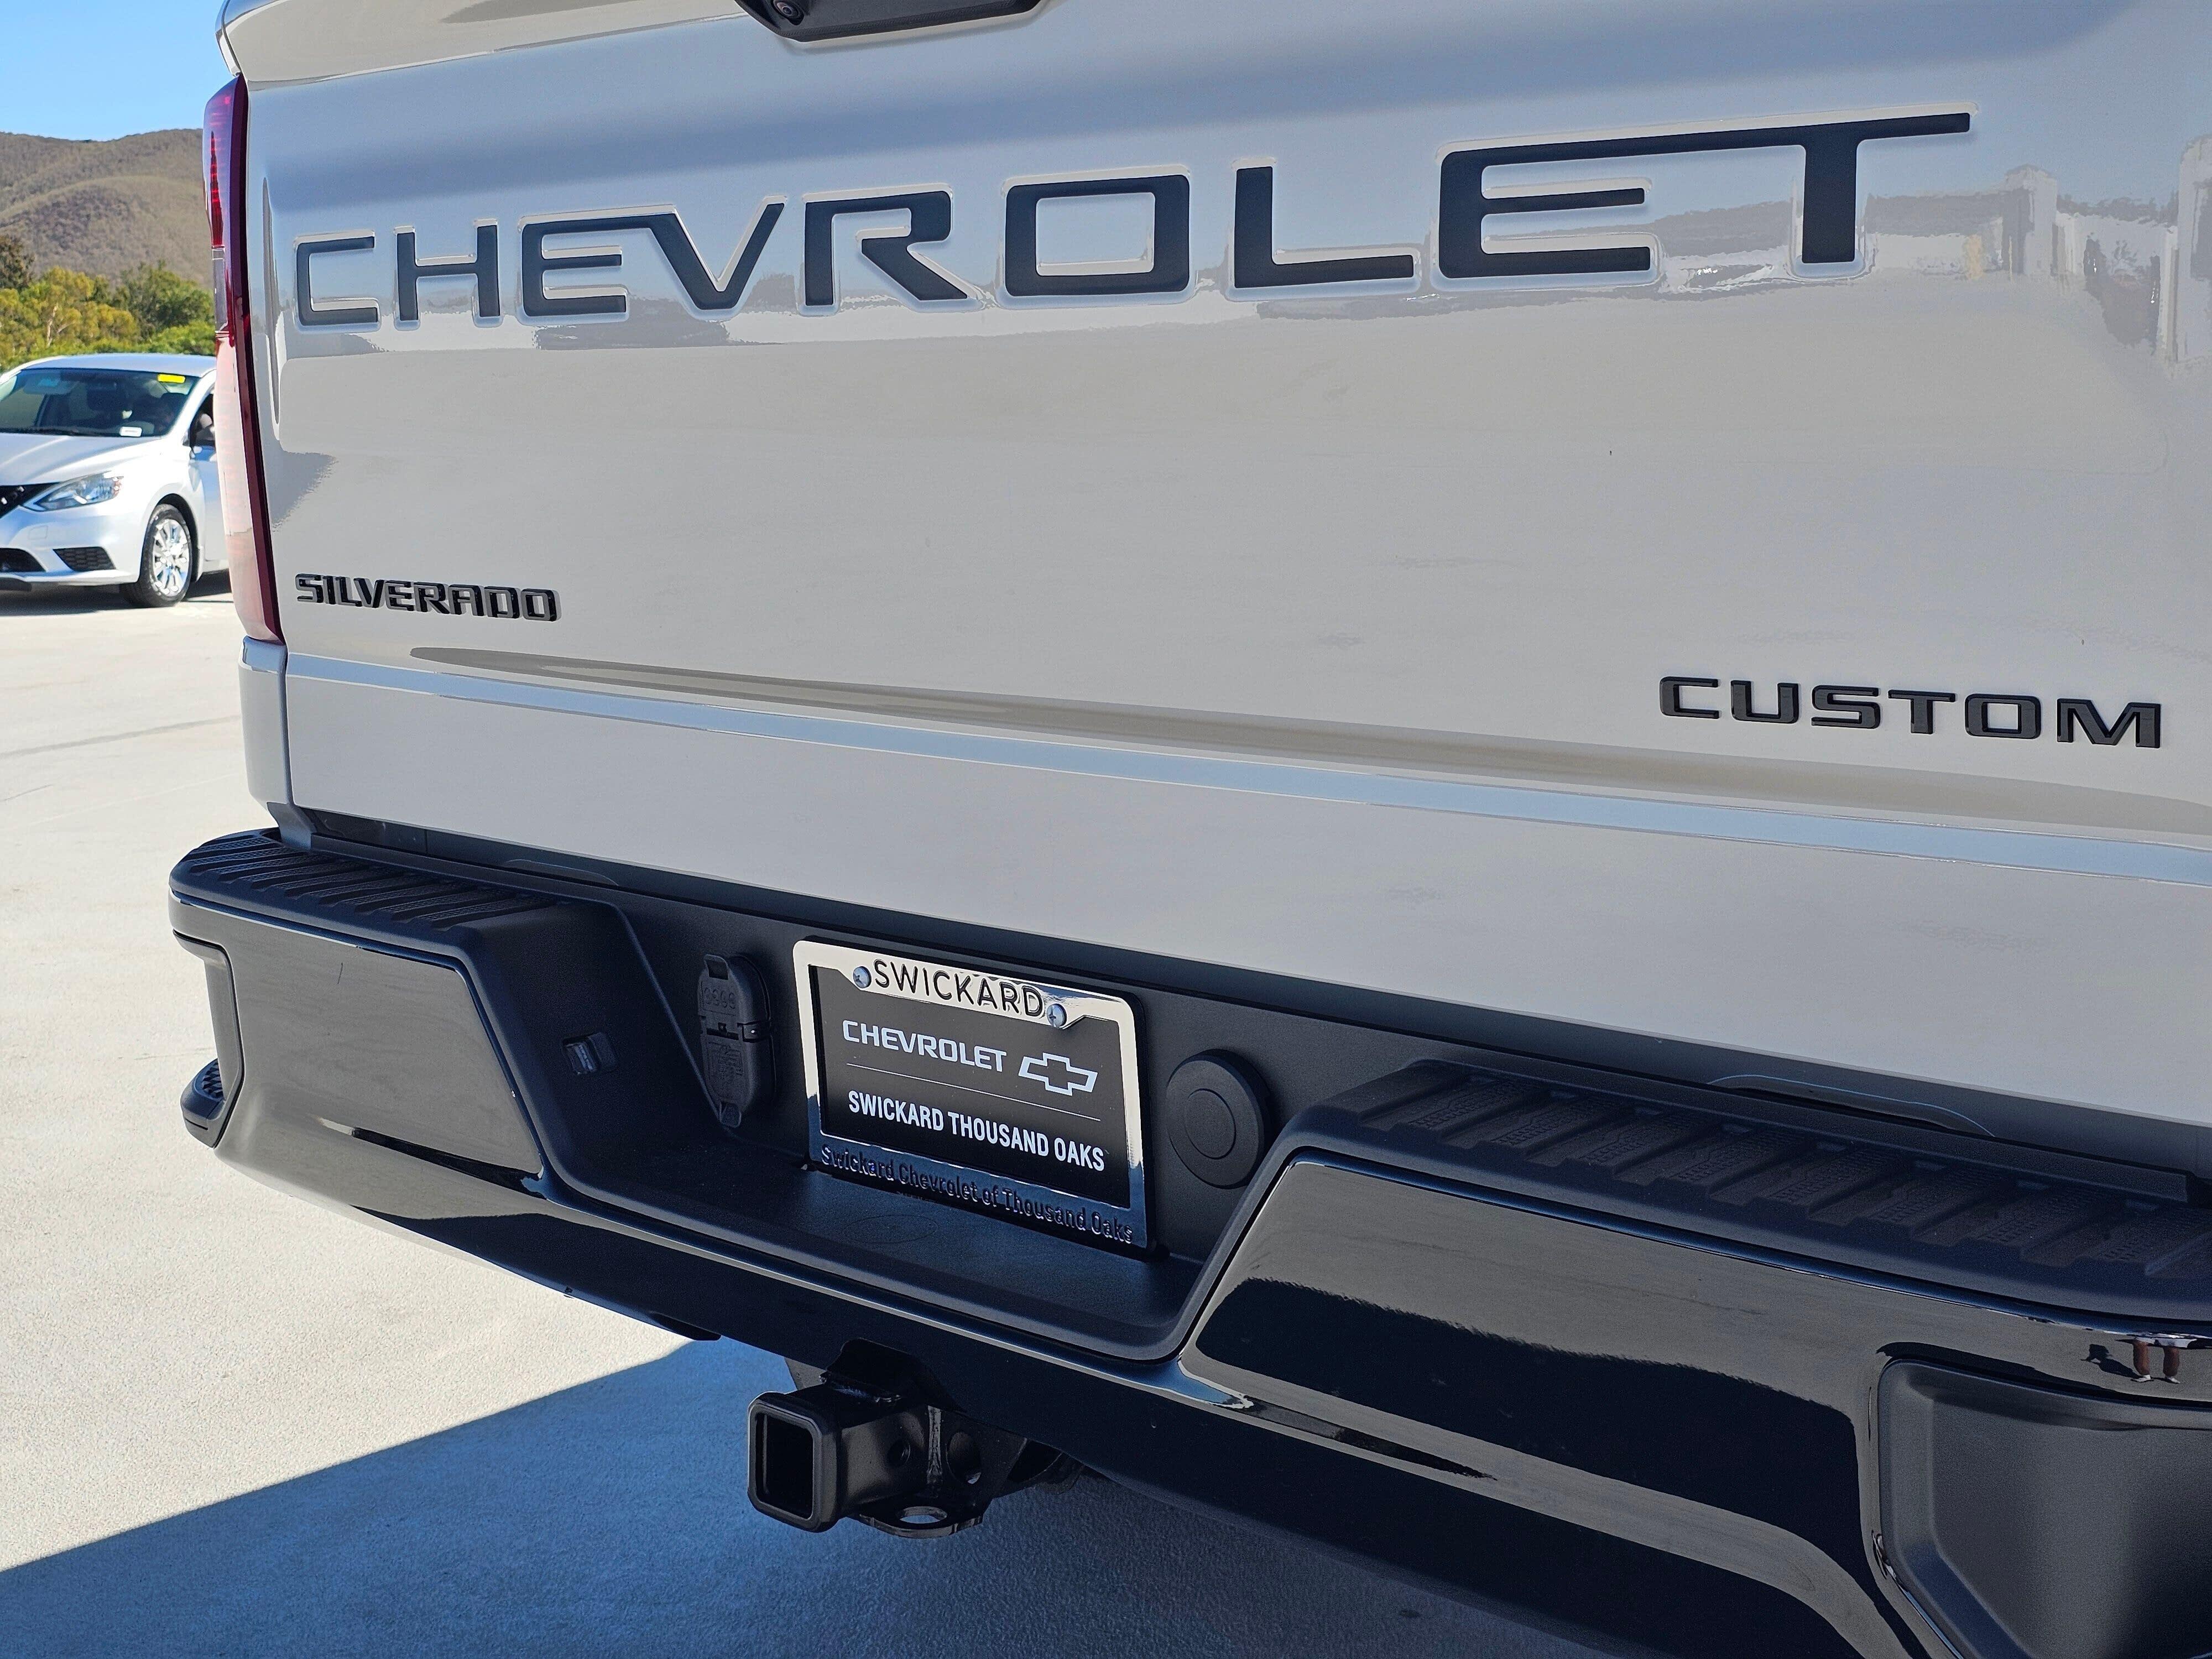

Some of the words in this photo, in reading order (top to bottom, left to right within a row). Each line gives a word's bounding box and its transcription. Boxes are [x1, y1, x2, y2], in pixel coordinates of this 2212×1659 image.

[295, 112, 1971, 327] CHEVROLET
[295, 573, 561, 622] SILVERADO
[1659, 676, 2162, 749] CUSTOM
[873, 958, 1044, 1018] SWICKARD
[842, 1020, 1007, 1073] CHEVROLET
[848, 1090, 944, 1131] SWICKARD
[947, 1111, 1048, 1157] THOUSAND
[1054, 1137, 1105, 1171] OAKS
[821, 1145, 895, 1182] Swickard
[899, 1162, 979, 1205] Chevrolet
[982, 1183, 999, 1207] of
[1001, 1187, 1087, 1231] Thousand
[1091, 1211, 1134, 1245] Oaks
